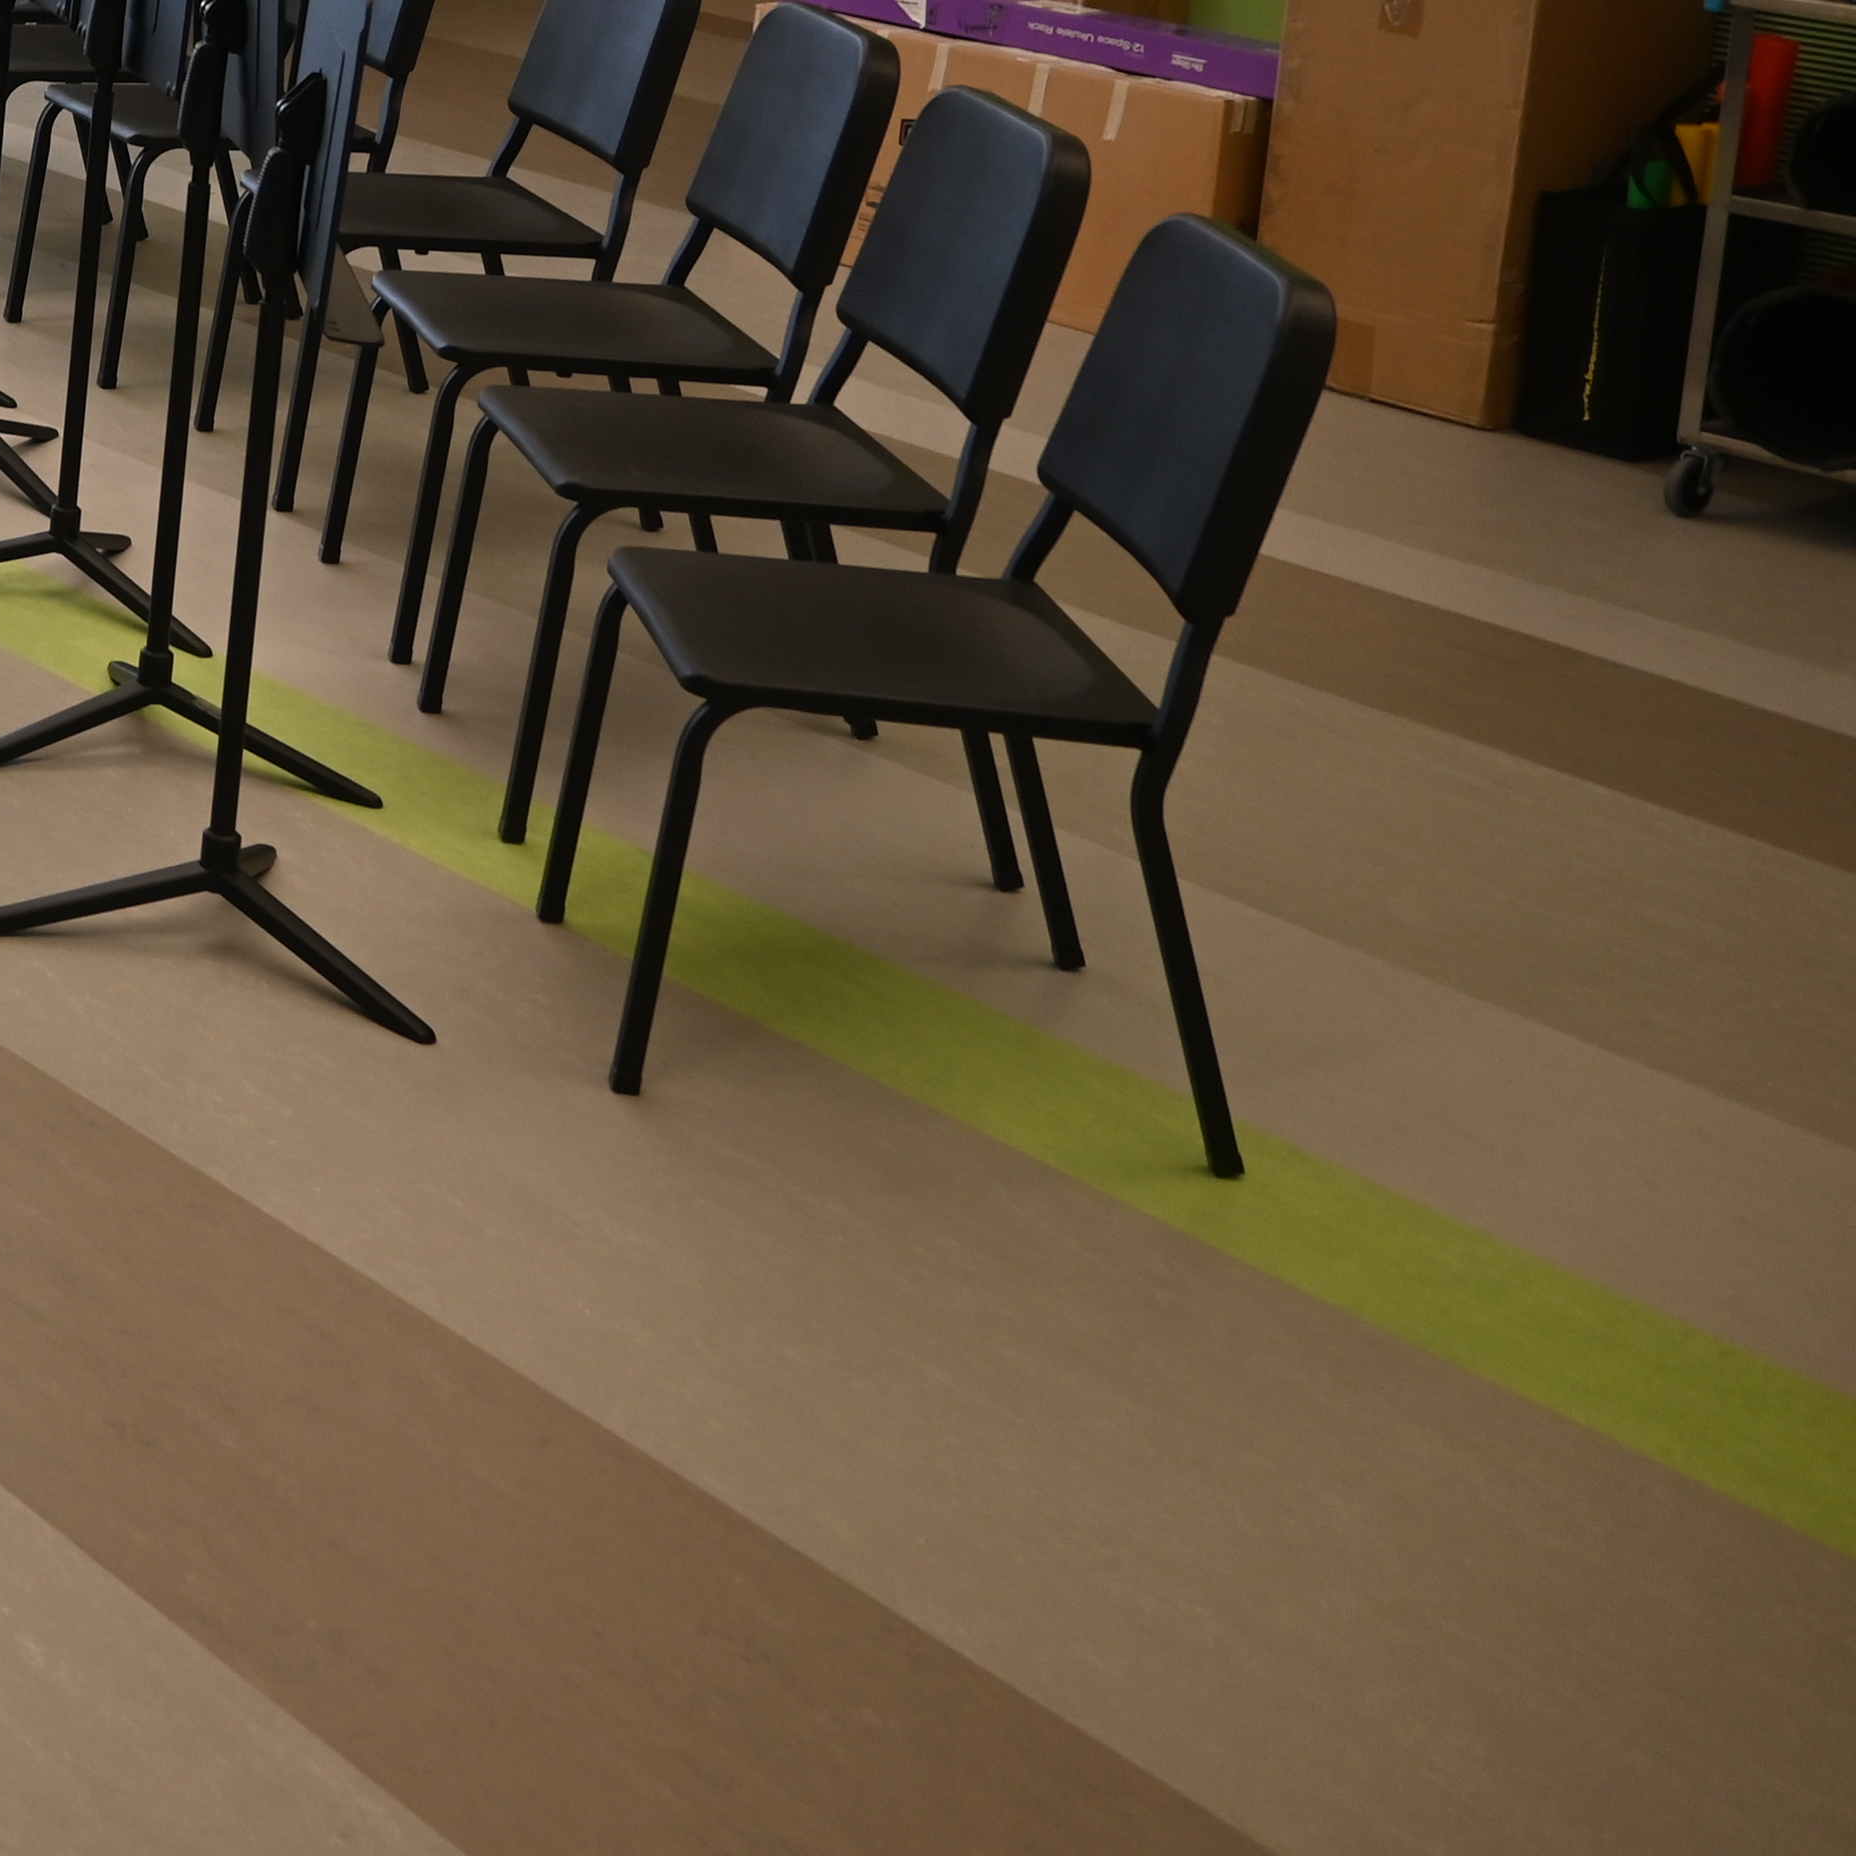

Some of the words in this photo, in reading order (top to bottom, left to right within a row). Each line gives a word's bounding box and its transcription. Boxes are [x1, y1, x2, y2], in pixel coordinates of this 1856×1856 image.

[1026, 20, 1054, 36] Rack
[1055, 25, 1095, 44] Ukulele
[1097, 34, 1145, 54] 12-Space
